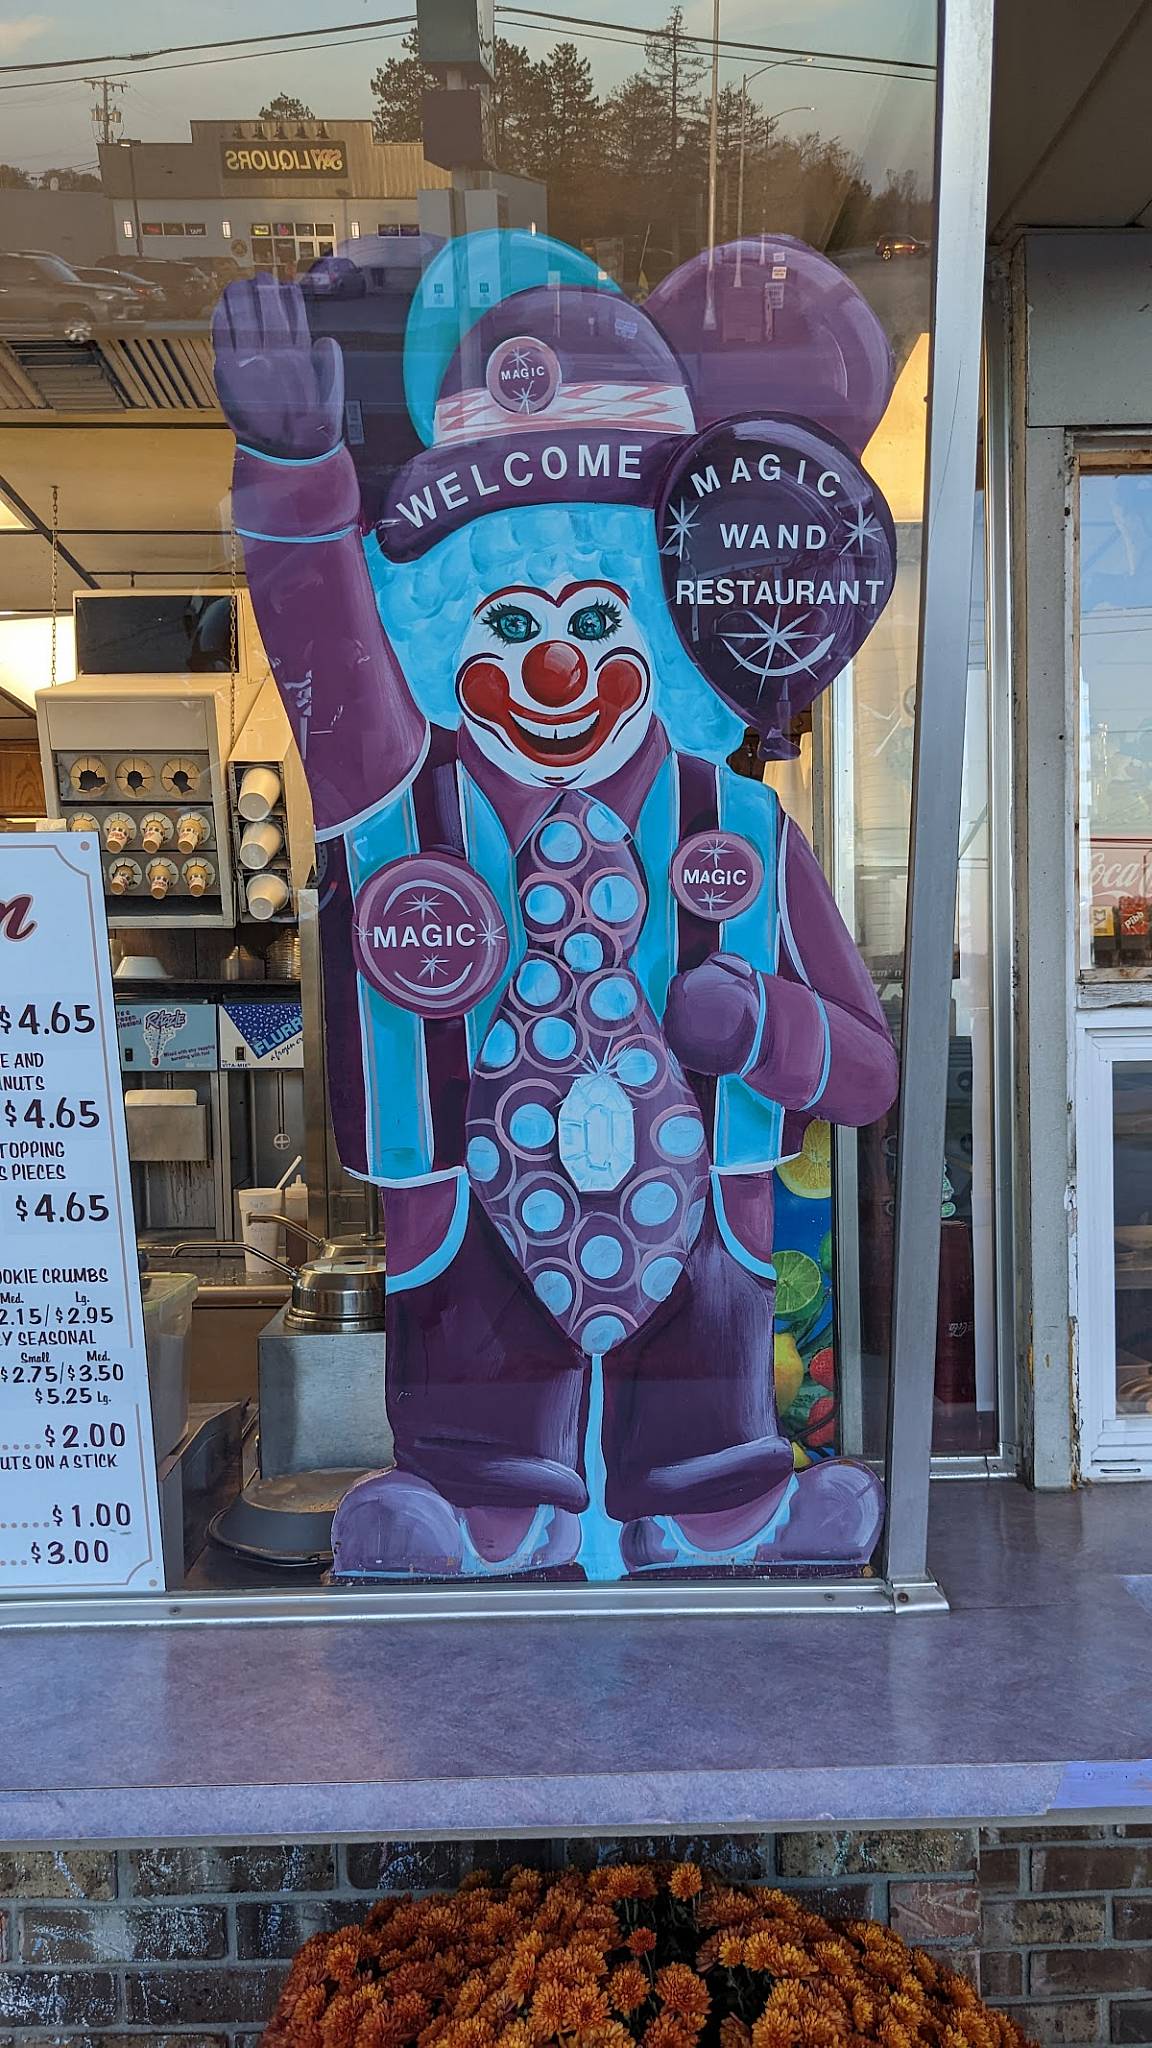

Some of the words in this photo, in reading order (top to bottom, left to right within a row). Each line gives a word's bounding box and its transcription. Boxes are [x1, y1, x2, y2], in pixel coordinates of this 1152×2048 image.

[501, 366, 545, 381] MAGIC
[690, 453, 840, 498] MAGIC
[395, 444, 642, 529] WELCOME
[719, 523, 826, 550] WAND
[676, 578, 884, 605] RESTAURANT
[683, 868, 748, 886] MAGIC
[1123, 911, 1145, 929] Pibb
[372, 923, 477, 949] MAGIC
[0, 1001, 96, 1035] $4.65
[14, 1052, 44, 1068] AND
[0, 1075, 45, 1091] NUTS
[5, 1097, 100, 1129] $4.65
[12, 1164, 66, 1180] PIECES
[15, 1192, 110, 1223] $4.65
[0, 1268, 38, 1285] OKIE
[42, 1267, 109, 1284] CRUMBS
[0, 1292, 24, 1304] Med.
[76, 1291, 90, 1306] Lg.
[0, 1331, 13, 1346] Y
[18, 1330, 97, 1346] SEASONAL
[21, 1352, 51, 1363] Small
[86, 1350, 111, 1362] Med.
[35, 1387, 93, 1405] $5.25
[97, 1391, 112, 1406] Lg.
[45, 1423, 126, 1449] $2.00
[35, 1455, 55, 1470] ON
[59, 1455, 70, 1470] A
[73, 1453, 119, 1468] STICK
[52, 1502, 131, 1528] $1.00
[31, 1540, 109, 1565] $3.00
